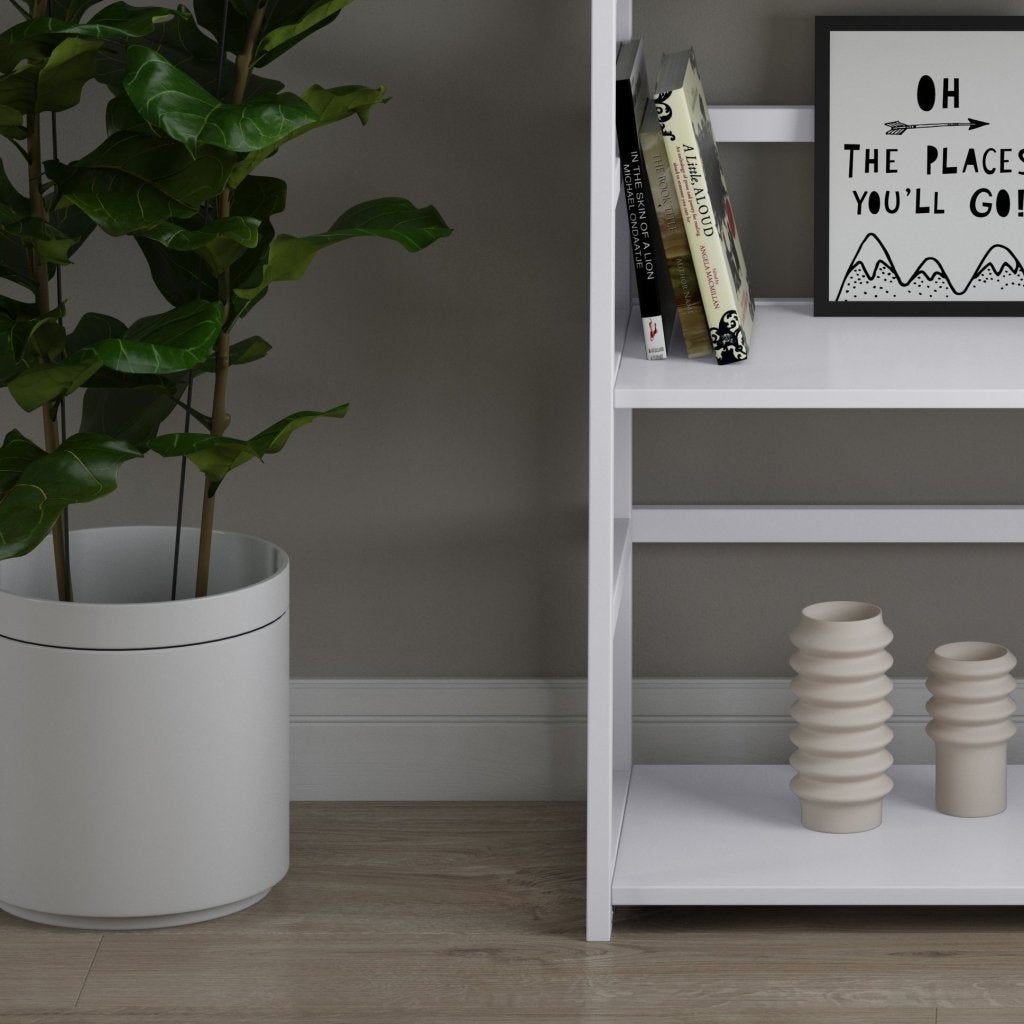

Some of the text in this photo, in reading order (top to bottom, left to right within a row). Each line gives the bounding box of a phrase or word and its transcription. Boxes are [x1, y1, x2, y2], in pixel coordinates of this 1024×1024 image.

[917, 75, 959, 112] OH
[844, 144, 898, 178] THE
[659, 176, 671, 204] BOOK
[683, 144, 714, 237] A Little, ALOUD
[853, 188, 1024, 218] YOU'LL GO!
[624, 164, 644, 269] MICHAEL ONDAATJE
[630, 151, 654, 280] IN THE SKIN OF A LION
[700, 245, 720, 309] ANGELA MACMILLAN
